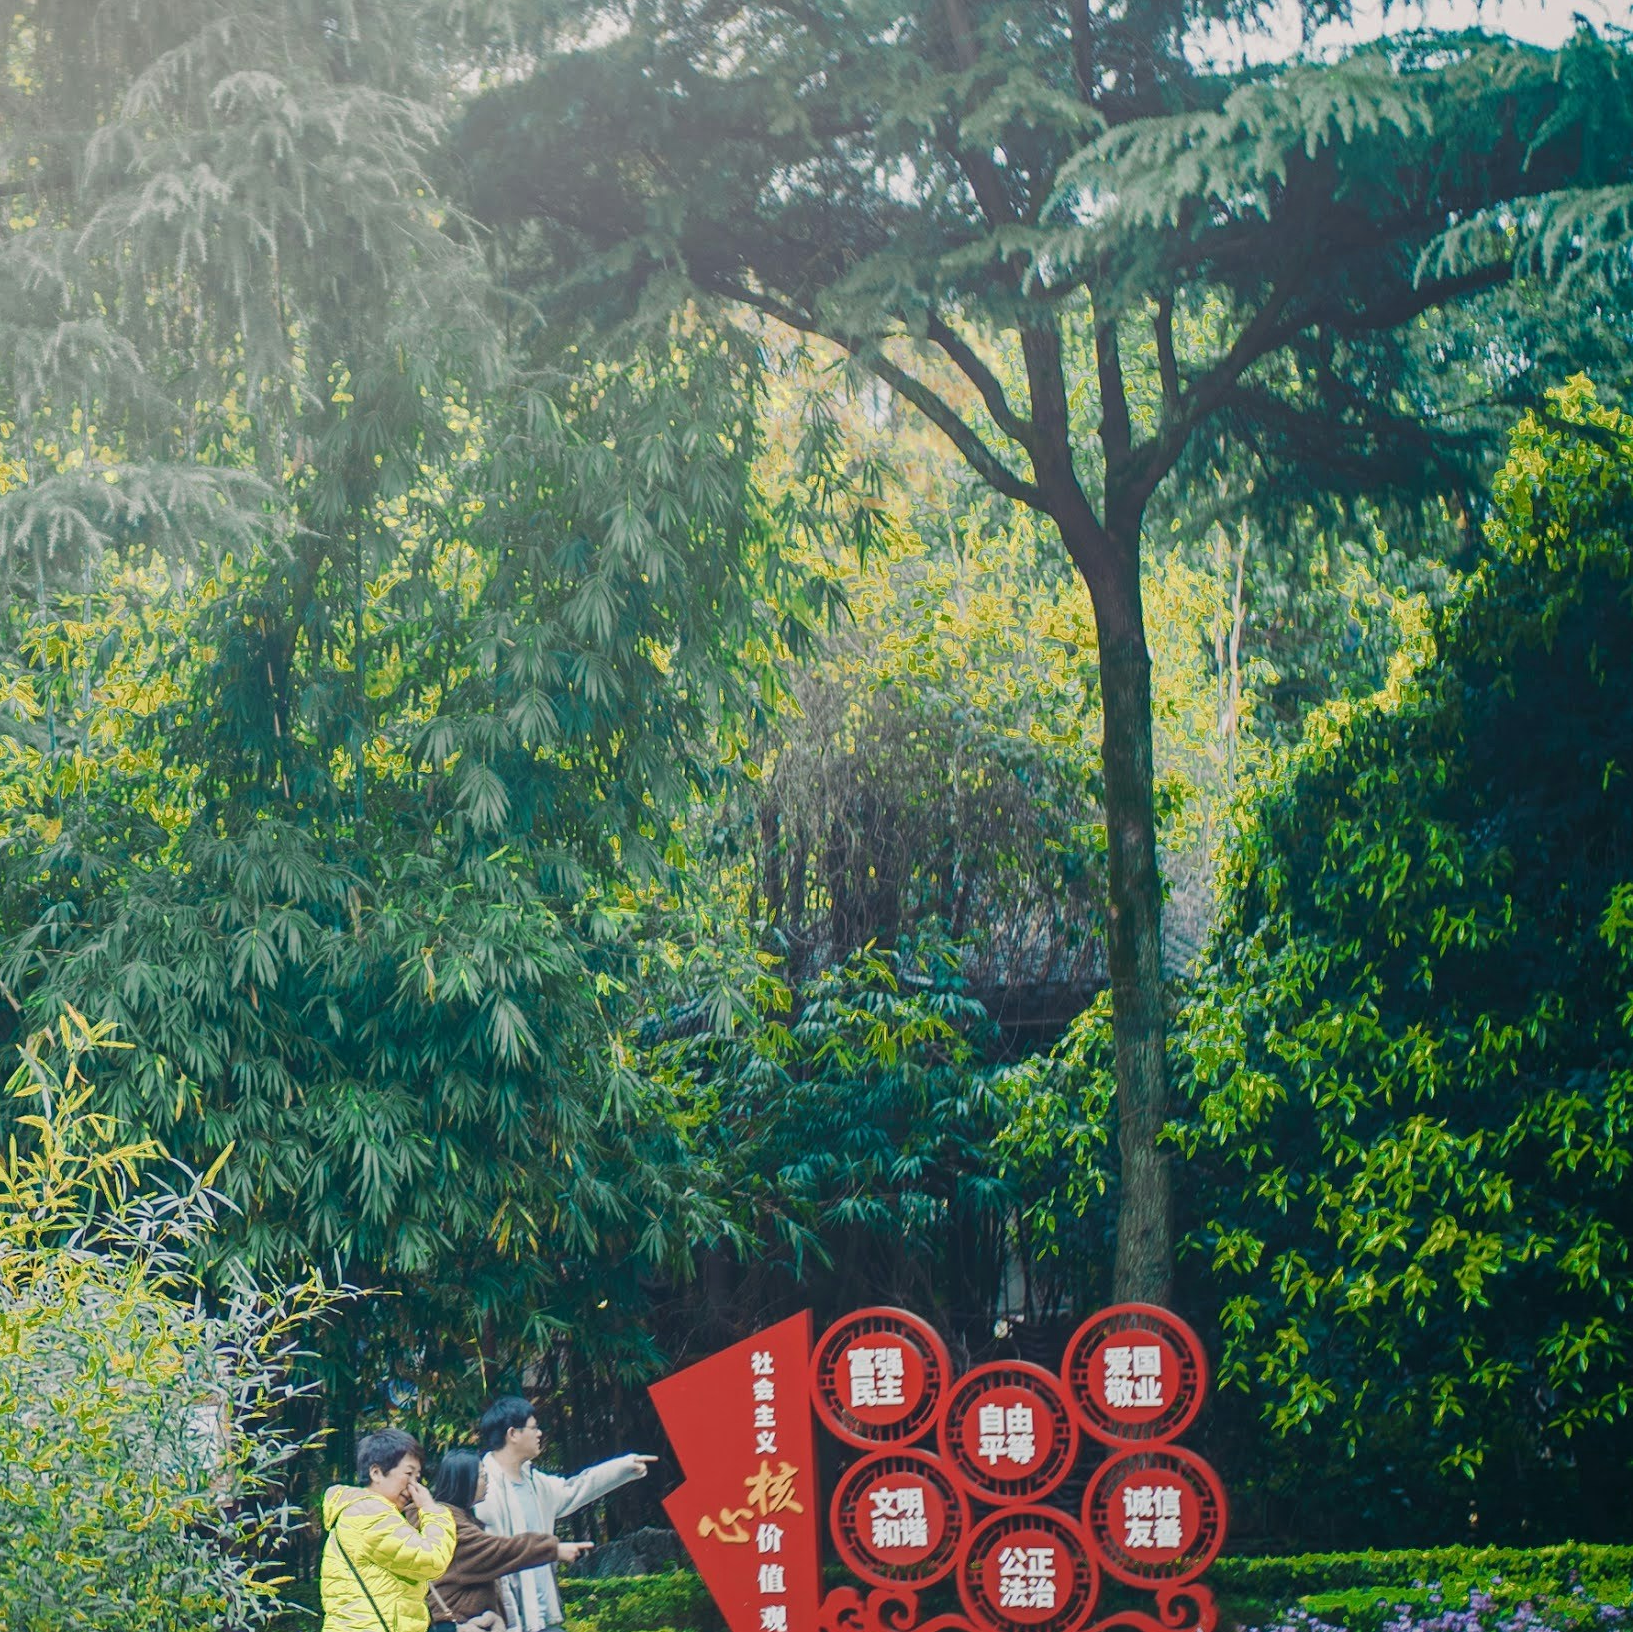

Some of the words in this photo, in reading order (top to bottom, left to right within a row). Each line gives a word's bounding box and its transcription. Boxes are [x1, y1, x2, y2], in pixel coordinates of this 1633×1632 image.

[847, 1347, 905, 1379] 富强
[1103, 1346, 1162, 1378] 爱国
[851, 1376, 905, 1408] 民主
[1104, 1376, 1164, 1408] 敬业
[978, 1402, 1034, 1435] 自由
[978, 1434, 1036, 1465] 平等
[869, 1487, 925, 1518] 文明
[1122, 1486, 1181, 1518] 诚信
[871, 1517, 928, 1548] 和谐
[1124, 1517, 1183, 1549] 友善
[997, 1547, 1056, 1578] 公正
[999, 1577, 1057, 1609] 法治
